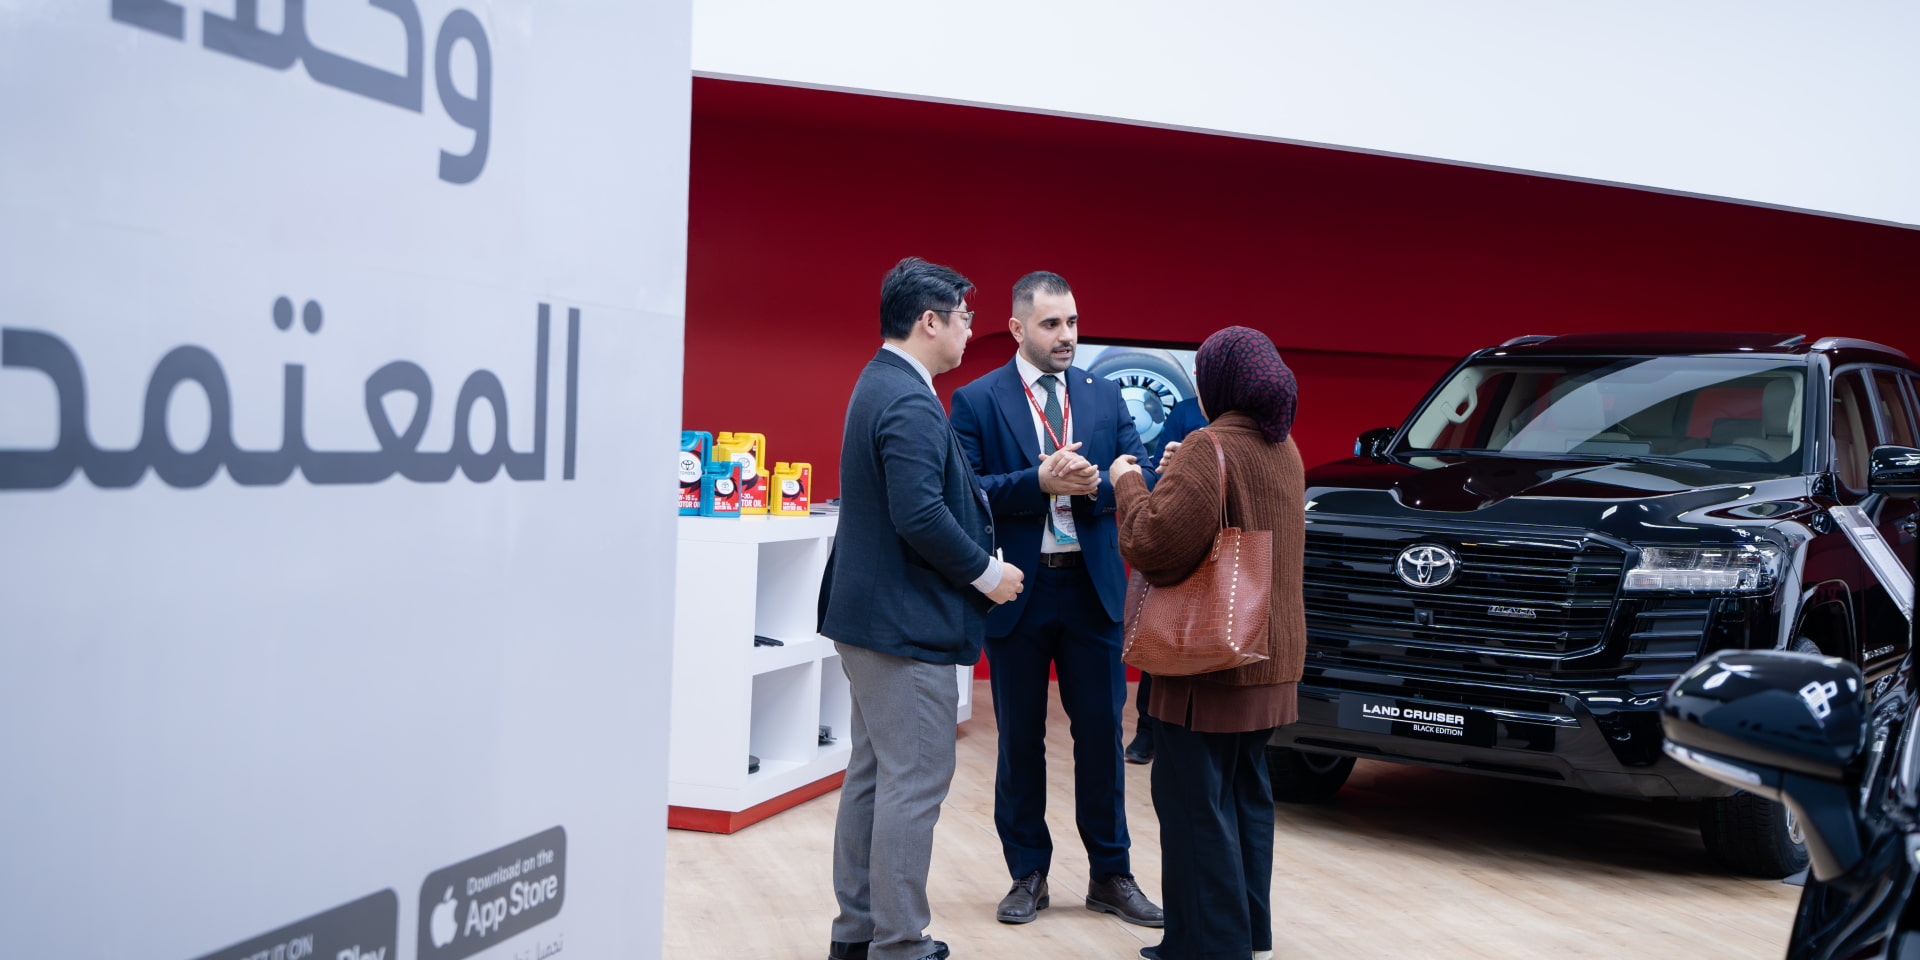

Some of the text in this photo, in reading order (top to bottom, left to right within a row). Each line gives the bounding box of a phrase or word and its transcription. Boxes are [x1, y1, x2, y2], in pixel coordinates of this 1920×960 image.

[741, 499, 753, 508] TOR
[1362, 703, 1464, 725] LAND CRUISER
[1413, 724, 1463, 737] BLACK EDITION
[466, 849, 554, 897] Download on the
[464, 874, 558, 938] App Store
[286, 934, 314, 960] ON
